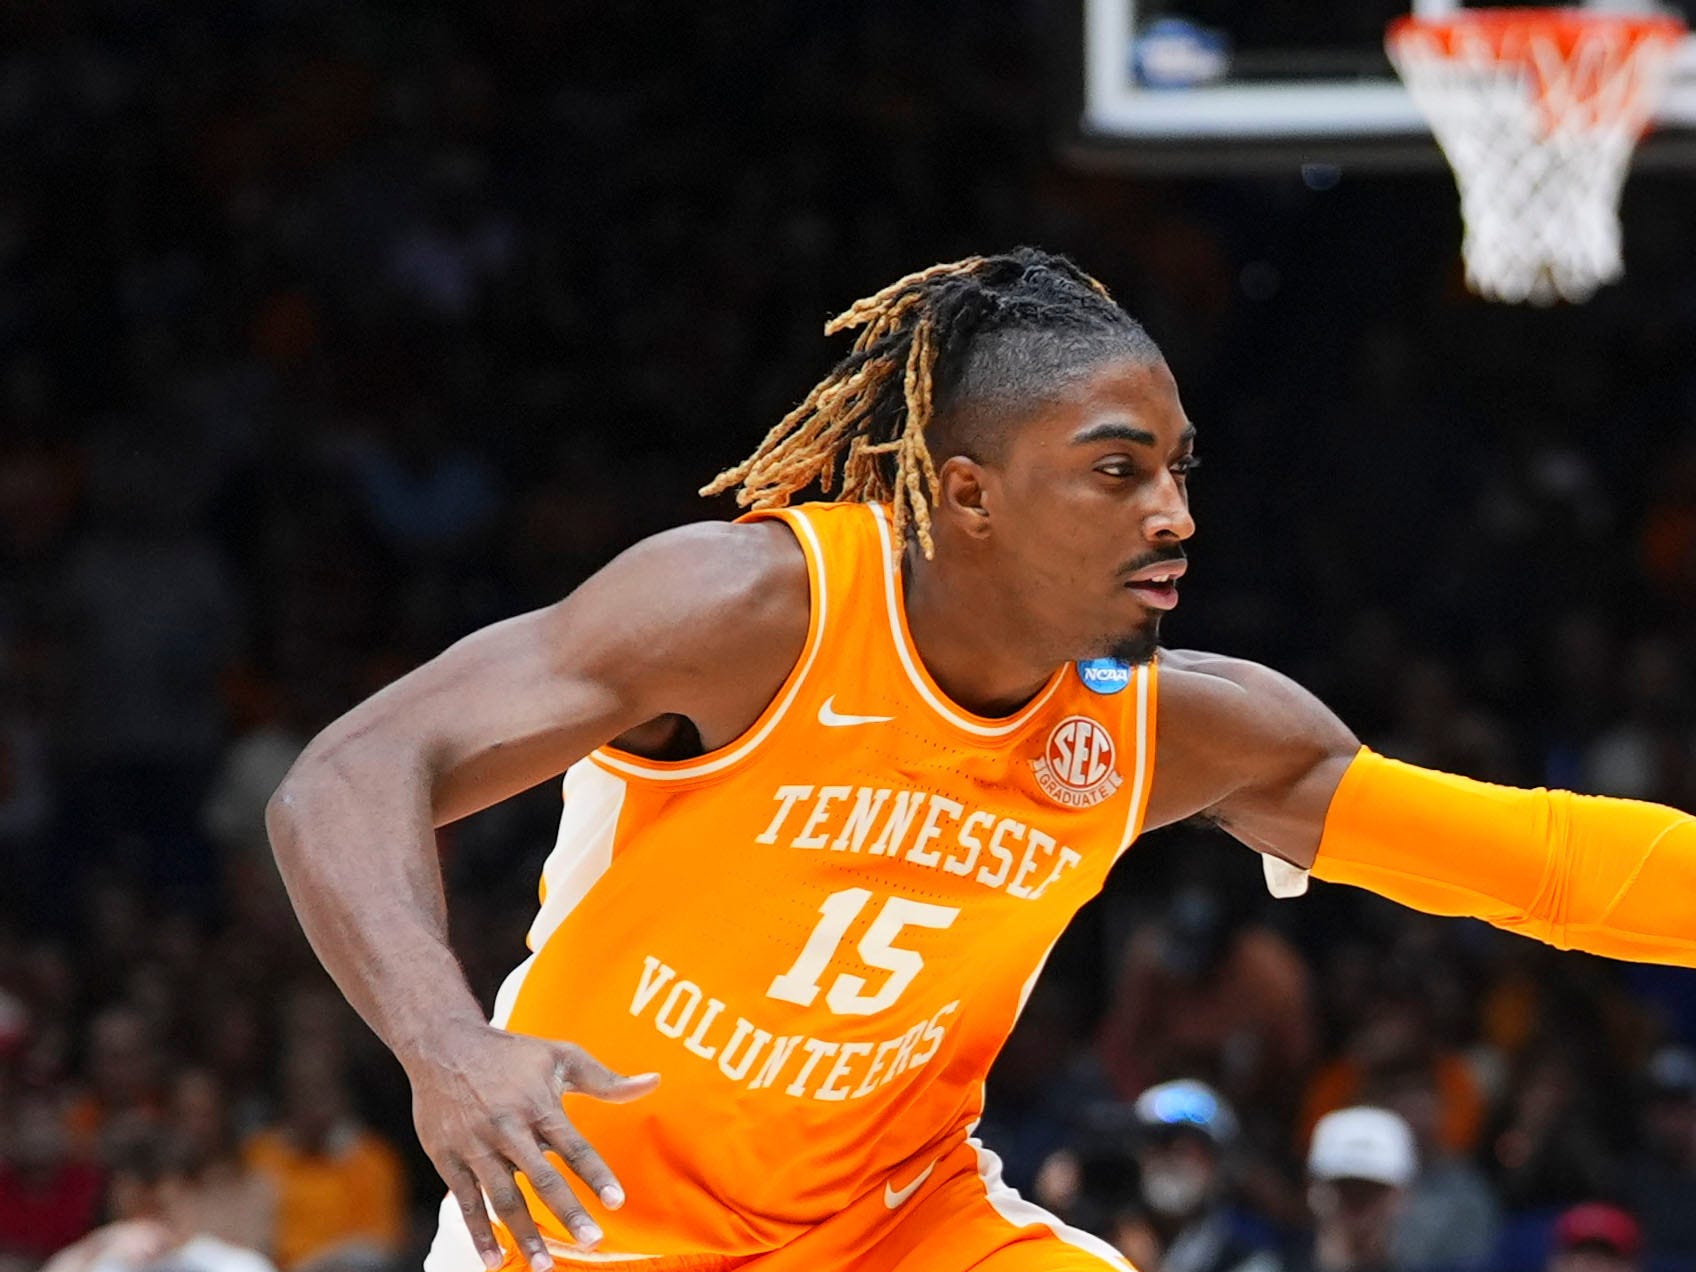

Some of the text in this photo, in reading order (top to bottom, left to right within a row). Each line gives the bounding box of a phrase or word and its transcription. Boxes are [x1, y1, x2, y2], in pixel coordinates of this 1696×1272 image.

[1084, 667, 1128, 682] NCAA
[1039, 773, 1110, 807] GRADUATE
[1052, 720, 1111, 785] SEC
[754, 784, 1082, 900] TENNESSEE
[766, 886, 962, 1016] 15
[628, 955, 960, 1101] VOLUNTEERS
